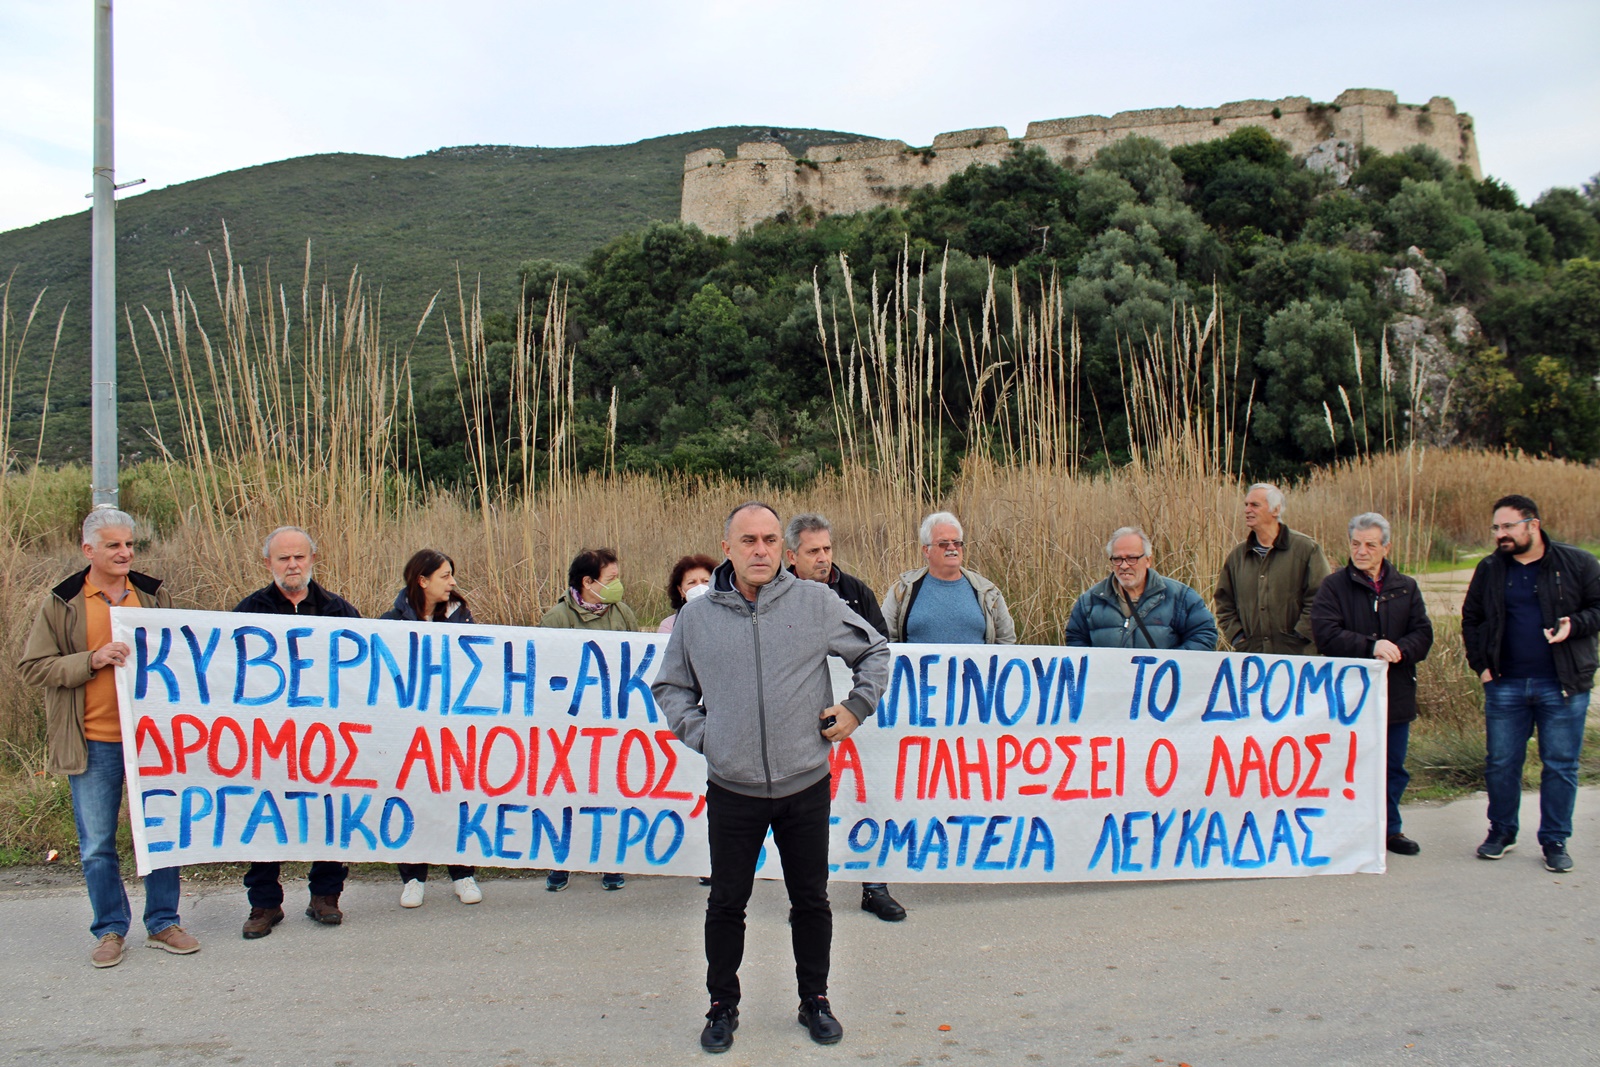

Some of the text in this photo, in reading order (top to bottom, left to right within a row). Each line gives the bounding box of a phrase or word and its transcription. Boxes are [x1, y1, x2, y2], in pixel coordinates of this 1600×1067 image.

[1129, 655, 1182, 723] ΤΟ
[1201, 655, 1372, 726] ΔΡΟΜΟ
[135, 713, 379, 789] ΔΡΟΜΟΣ
[894, 733, 1126, 802] ΠΛΗΡΩΣΕΙ
[1145, 737, 1179, 798] Ο
[1204, 731, 1357, 800] ΛΑΟΣ!
[142, 785, 415, 853] ΕΡΓΑΤΙΚΟ
[456, 801, 685, 866] ΚΕΝΤΡΟ
[1087, 807, 1332, 874] ΛΕΥΚΑΔΑΣ
